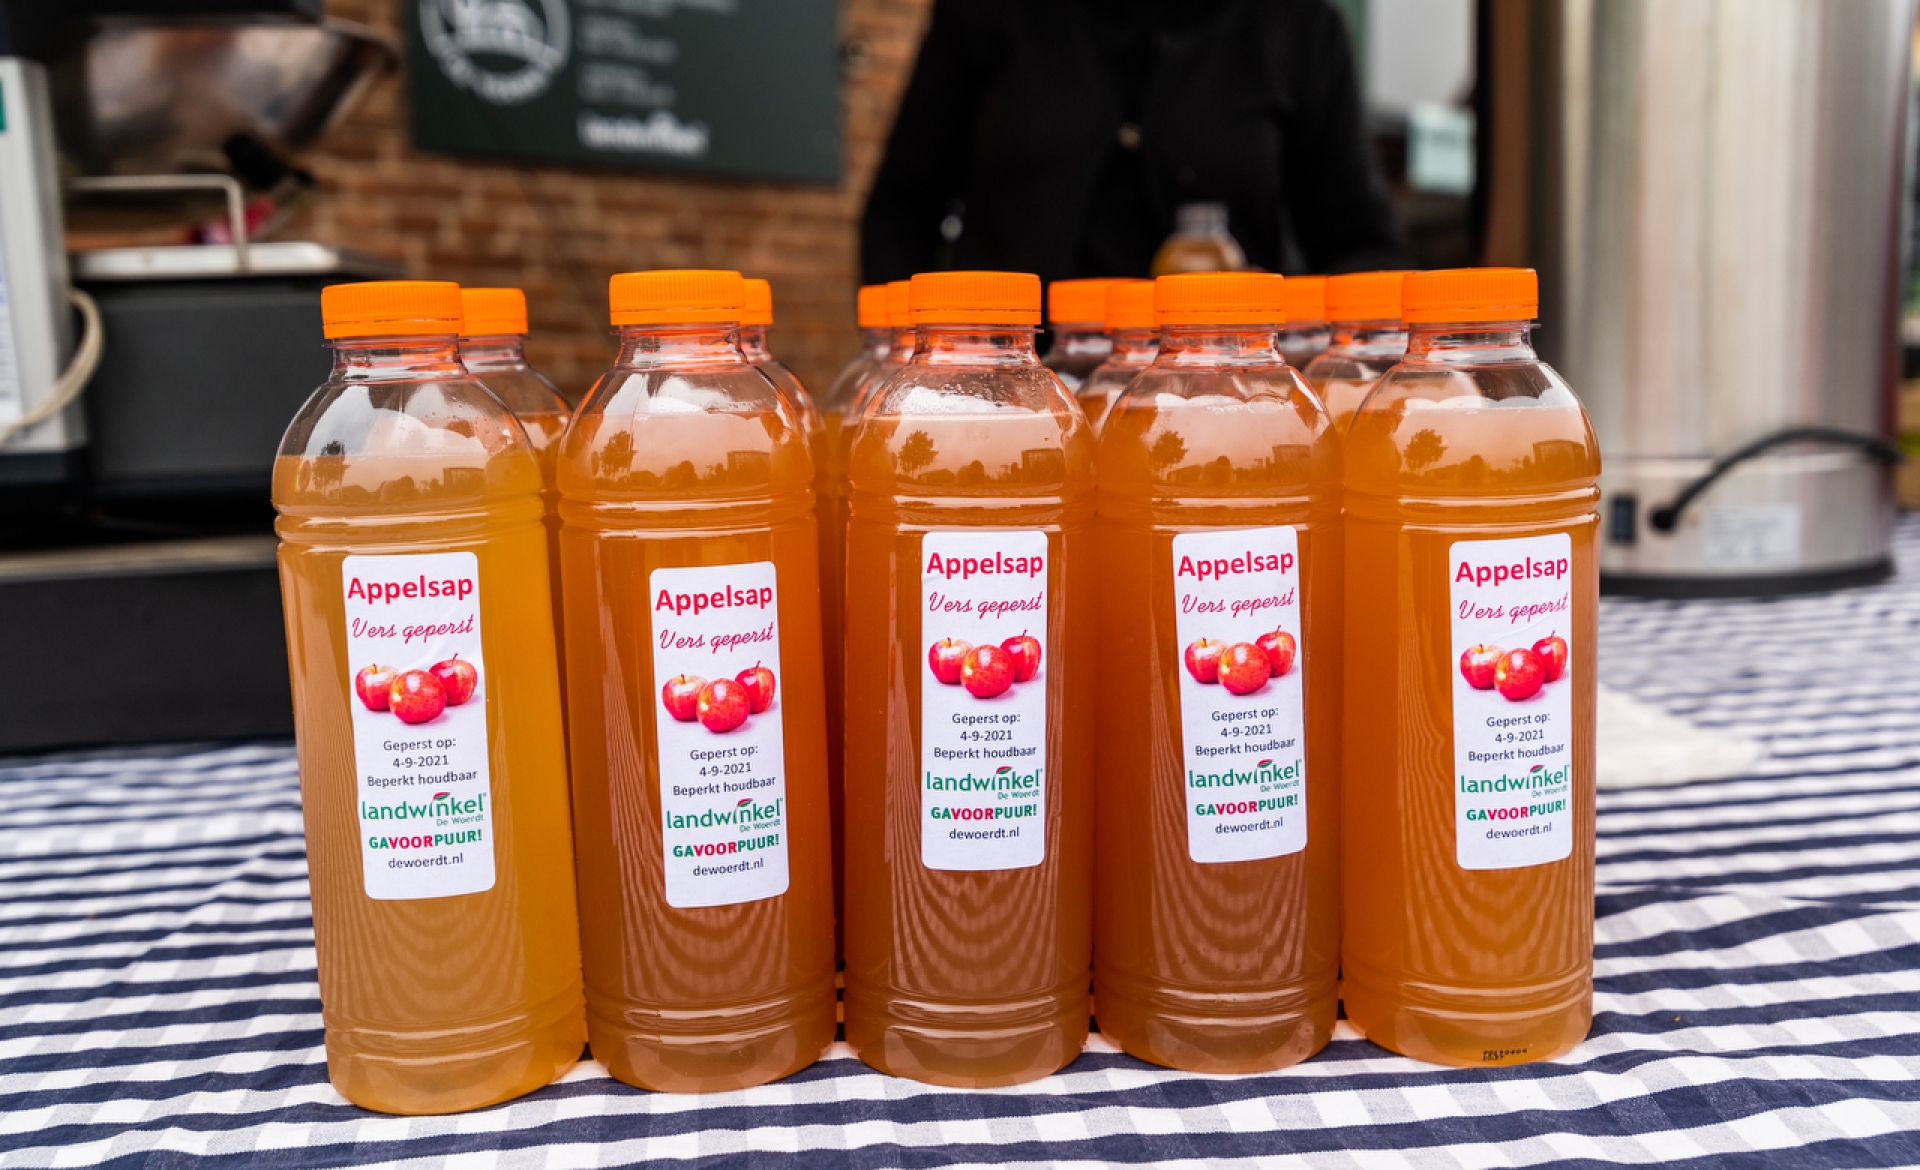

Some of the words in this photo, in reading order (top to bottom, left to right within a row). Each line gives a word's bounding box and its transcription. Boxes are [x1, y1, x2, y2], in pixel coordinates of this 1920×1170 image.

[926, 551, 1043, 580] Appelsap
[1178, 551, 1293, 581] Appelsap
[1455, 557, 1568, 587] Appelsap
[347, 575, 473, 605] Appelsap
[655, 585, 773, 615] Appelsap
[929, 591, 973, 613] Vers
[978, 591, 1042, 620] geperst
[1182, 594, 1225, 613] Vers
[1232, 588, 1295, 618] geperst
[1459, 600, 1504, 620] Vers
[1510, 593, 1568, 624] geperst
[351, 617, 397, 640] Vers
[402, 613, 474, 644] geperst
[660, 629, 705, 650] Vers
[710, 622, 774, 653] geperst
[952, 713, 998, 725] Geperst
[1002, 713, 1020, 725] op:
[1212, 709, 1257, 723] Geperst
[1261, 707, 1279, 720] op:
[1486, 714, 1532, 728] Geperst
[1534, 712, 1550, 725] op:
[960, 730, 1012, 741] 4-9-2021
[1220, 724, 1272, 738] 4-9-2021
[1495, 729, 1544, 743] 4-9-2021
[383, 738, 432, 752] Geperst
[436, 737, 456, 750] op:
[934, 747, 980, 759] Beperkt
[983, 746, 1037, 759] houdbaar
[1195, 744, 1241, 757] Beperkt
[1244, 738, 1295, 753] houdbaar
[1468, 748, 1514, 762] Beperkt
[1517, 743, 1565, 758] houdbaar
[393, 755, 449, 769] 4-9-2021
[690, 747, 737, 762] Geperst
[741, 745, 758, 758] op:
[367, 776, 415, 788] Beperkt
[418, 769, 478, 785] houdbaar
[699, 763, 751, 777] 4-9-2021
[673, 783, 720, 796] Beperkt
[723, 777, 776, 793] houdbaar
[1010, 790, 1039, 798] Woerdt
[1273, 780, 1299, 791] Woerdt
[1544, 785, 1567, 796] Woerdt
[436, 818, 448, 826] De
[451, 814, 484, 825] Woerdt
[753, 819, 781, 831] Woerdt
[1215, 816, 1283, 834] dewoerdt.nl
[949, 827, 1020, 839] dewoerdt.nl
[1486, 821, 1551, 839] dewoerdt.nl
[388, 853, 463, 869] dewoerdt.nl
[693, 858, 764, 876] dewoerdt.nl
